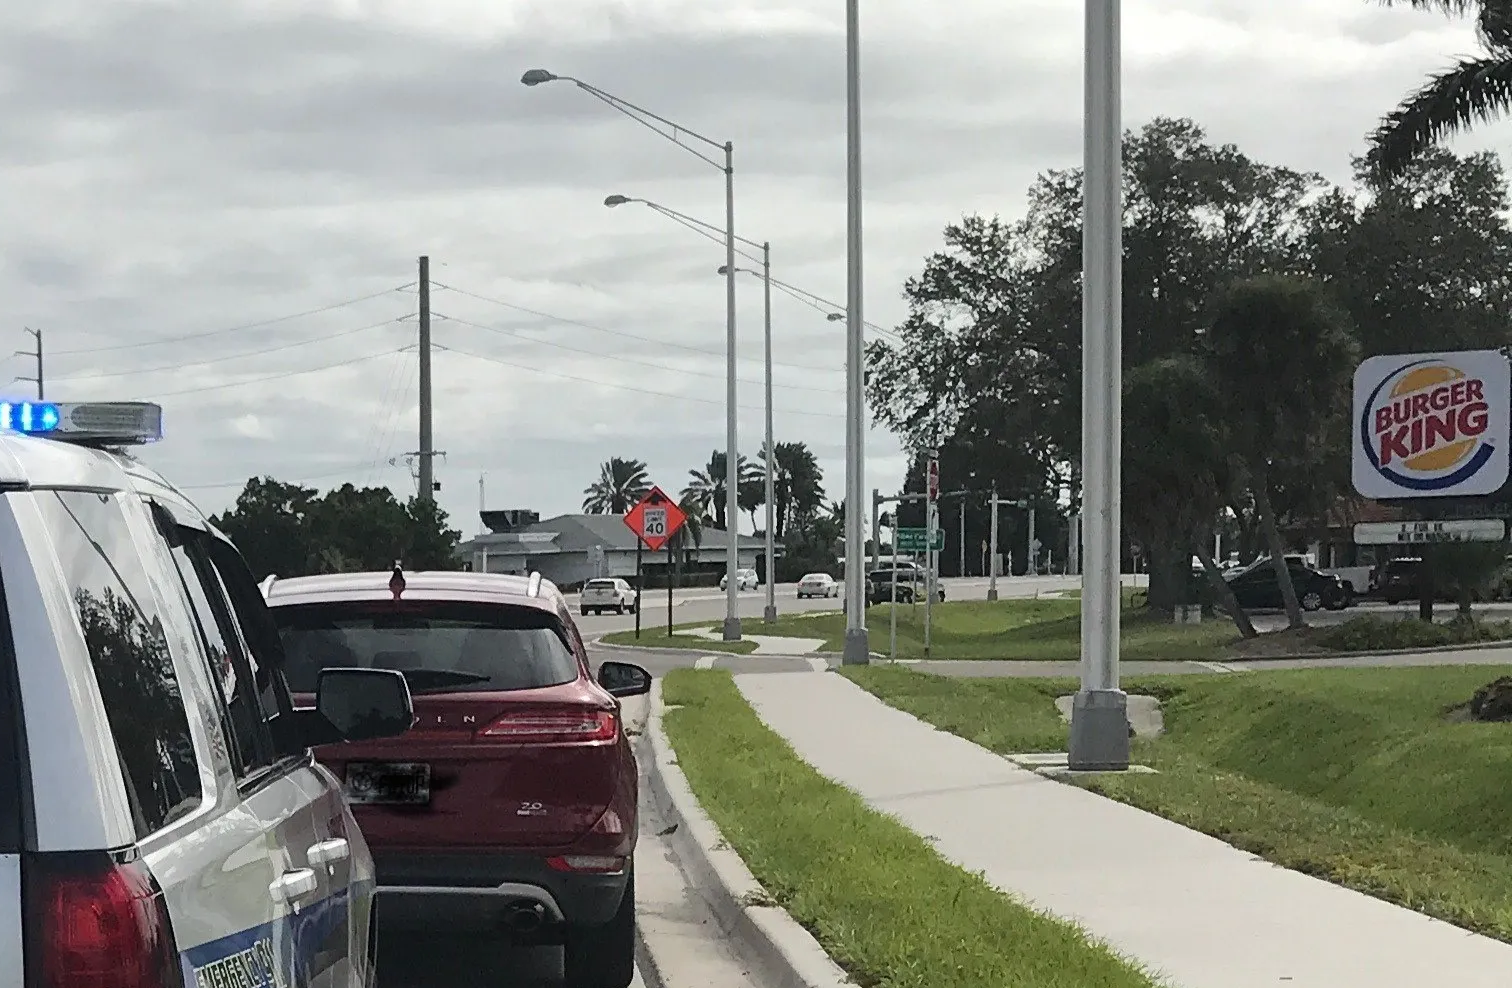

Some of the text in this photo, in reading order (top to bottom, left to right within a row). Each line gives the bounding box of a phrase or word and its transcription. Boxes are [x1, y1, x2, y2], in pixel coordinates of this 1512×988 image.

[1375, 379, 1484, 434] BURGER
[1380, 402, 1489, 466] KING
[645, 522, 664, 534] 40
